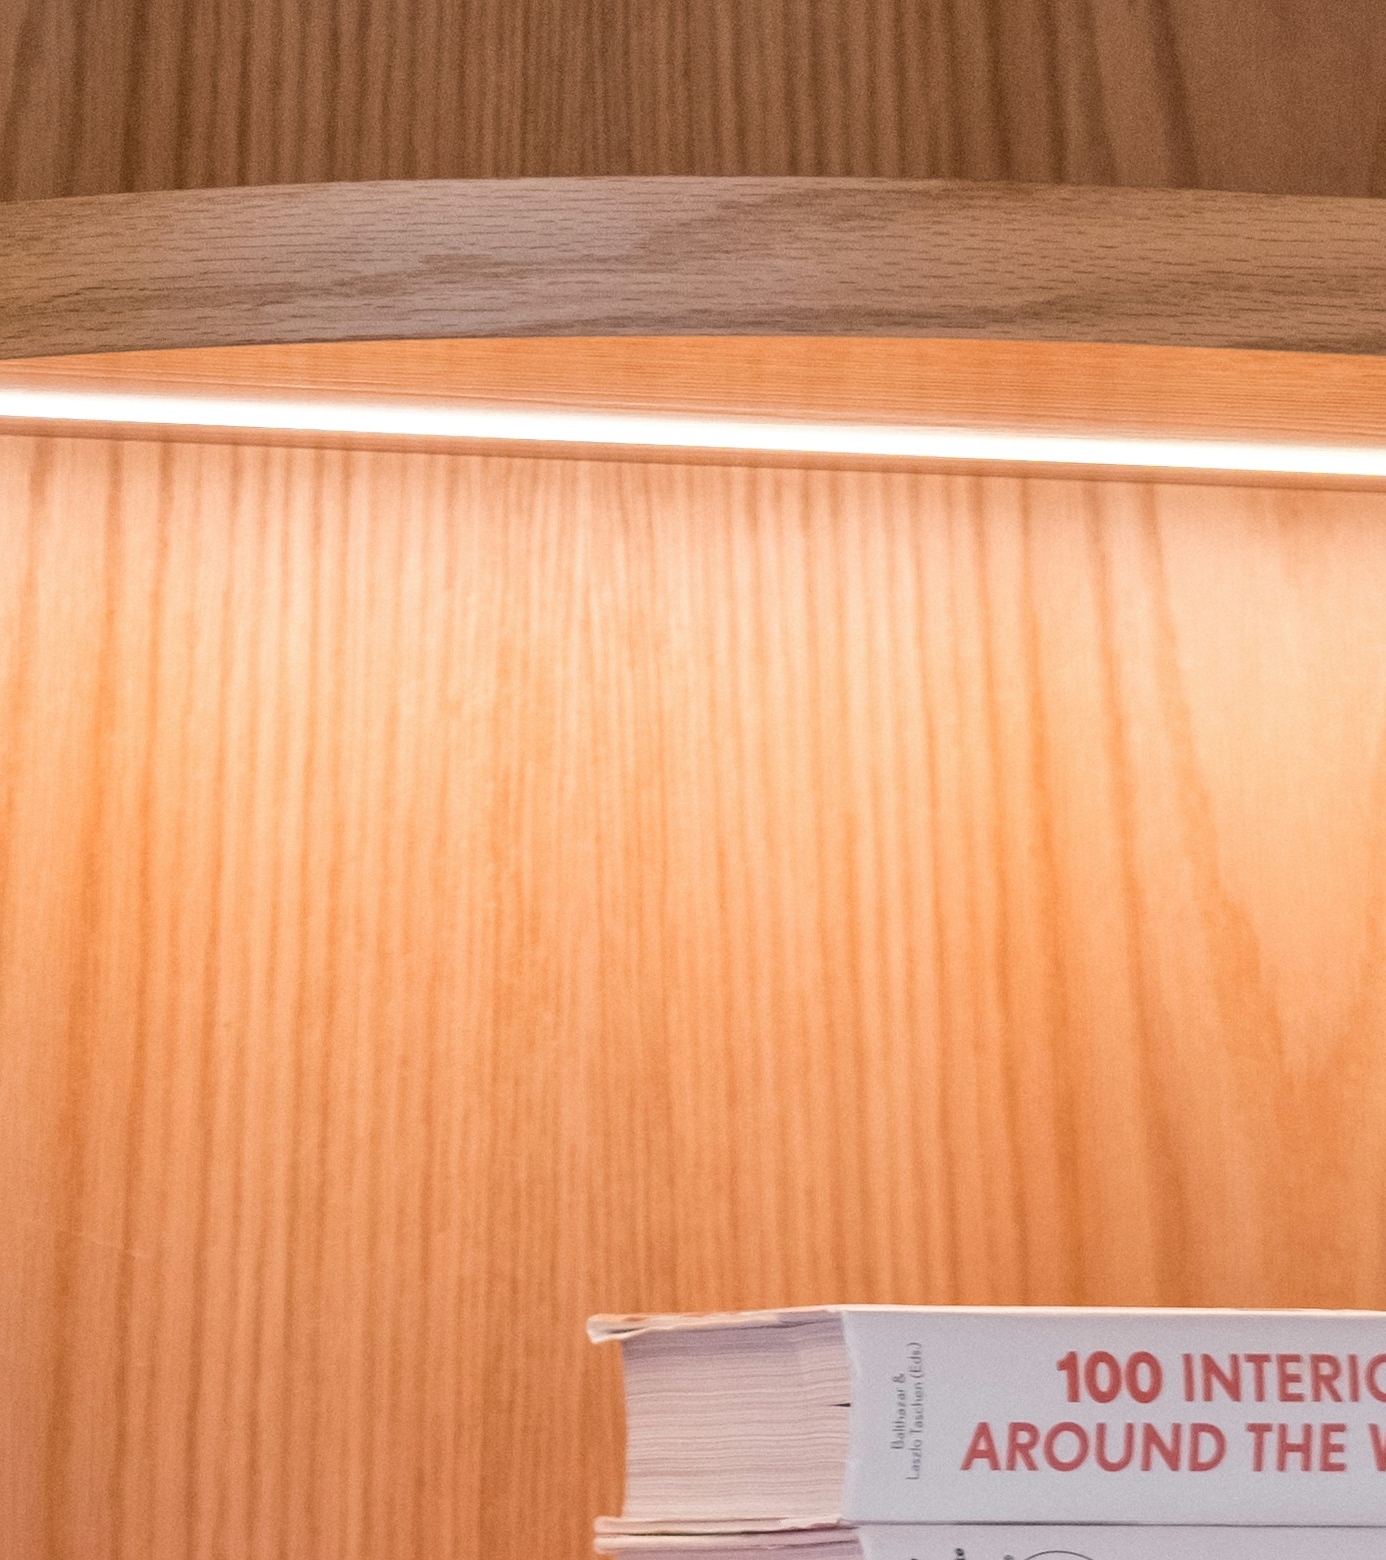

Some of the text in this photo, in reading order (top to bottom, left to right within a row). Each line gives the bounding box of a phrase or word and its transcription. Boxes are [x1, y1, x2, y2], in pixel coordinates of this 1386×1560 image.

[1056, 1350, 1162, 1403] 100
[908, 1382, 924, 1434] Taschen
[961, 1422, 1227, 1473] AROUND
[1245, 1422, 1349, 1473] THE
